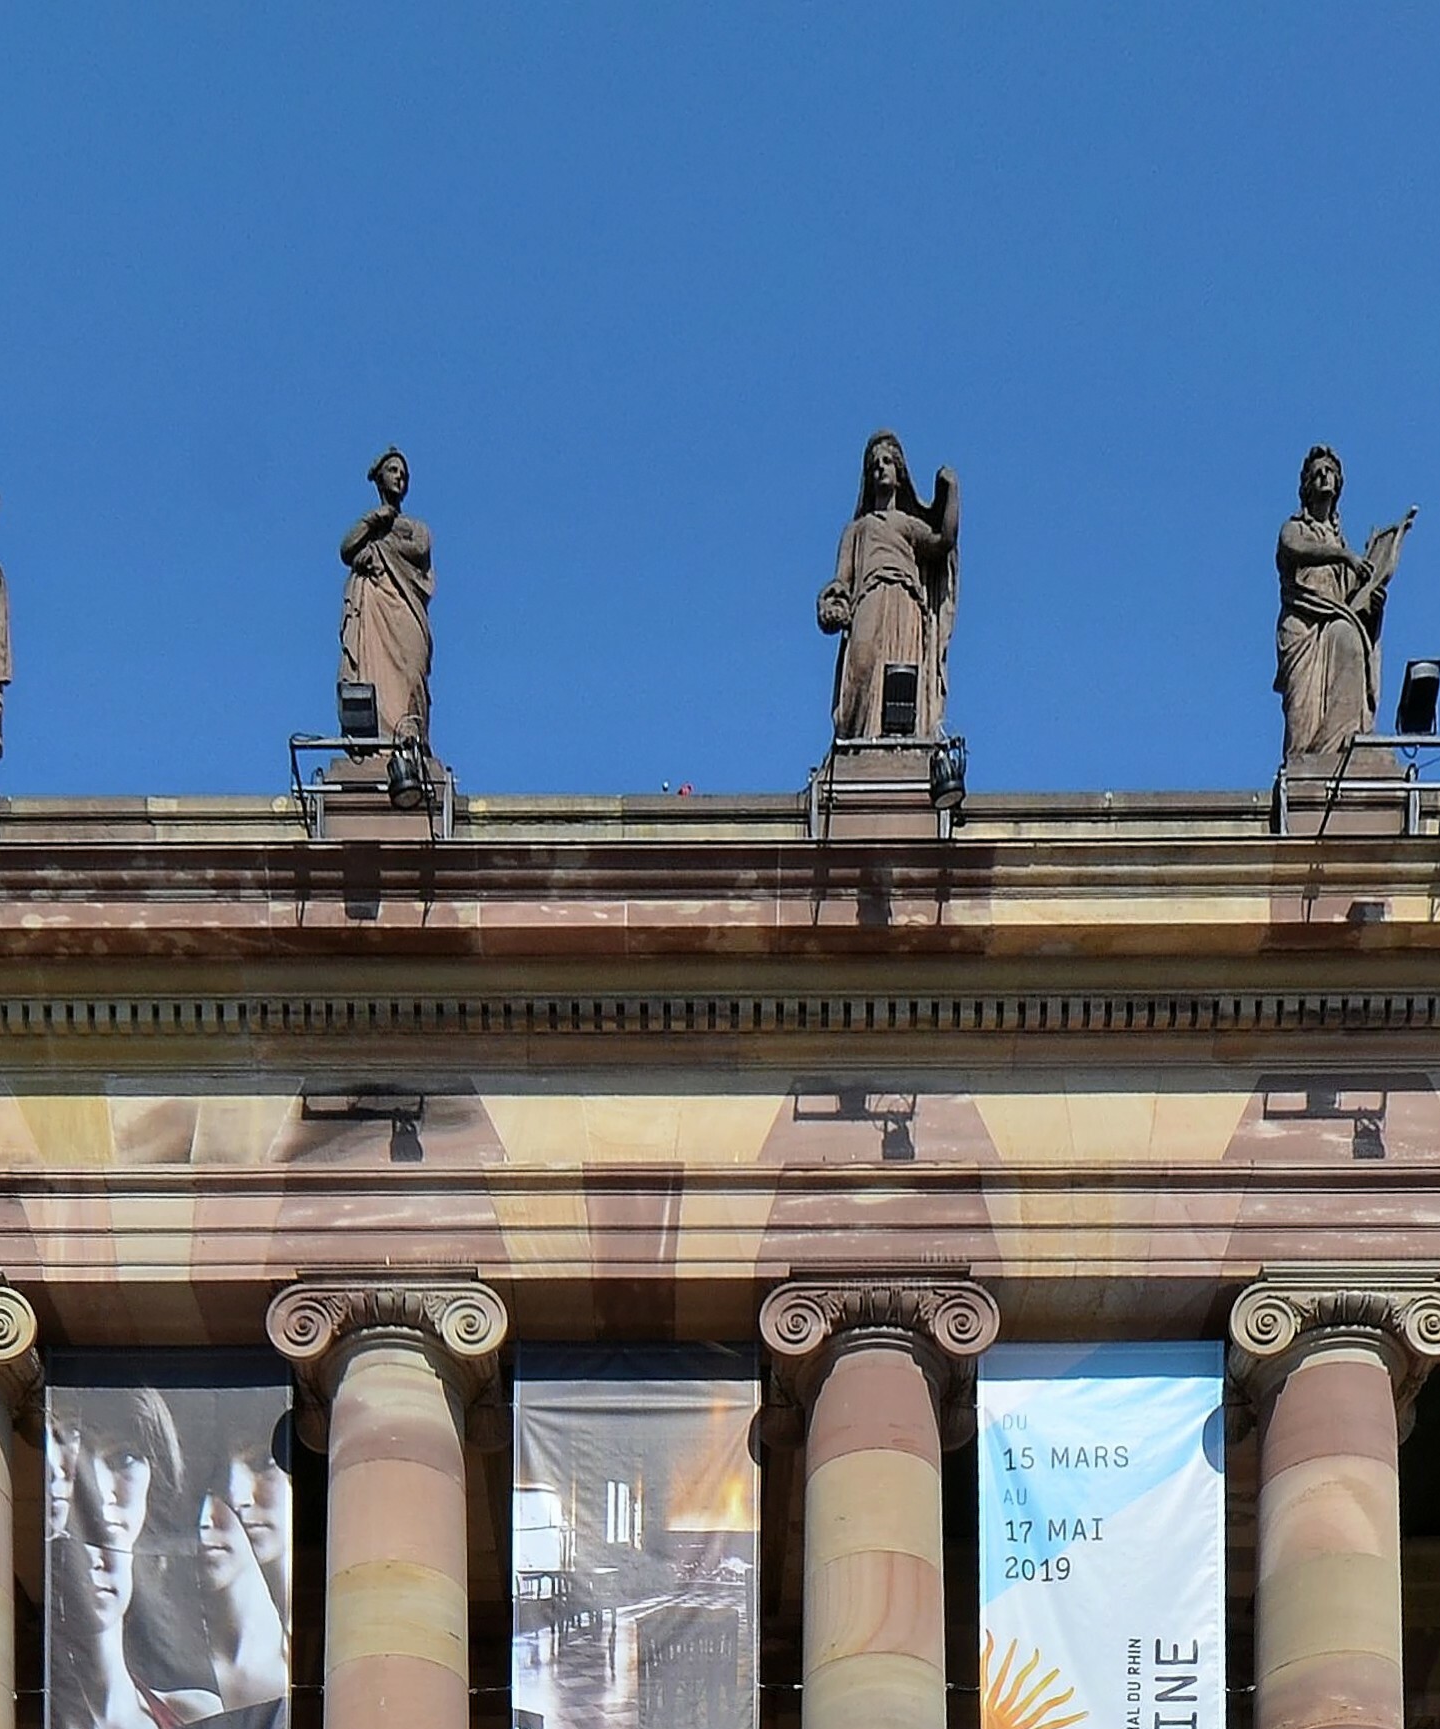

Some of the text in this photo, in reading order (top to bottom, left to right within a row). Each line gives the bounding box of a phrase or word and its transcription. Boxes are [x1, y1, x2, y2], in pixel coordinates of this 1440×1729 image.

[1002, 1413, 1027, 1430] DU
[1003, 1446, 1129, 1471] 15 MARS
[1003, 1488, 1028, 1505] AU
[1005, 1517, 1104, 1543] 17 MAI
[1005, 1556, 1071, 1582] 2019
[1127, 1638, 1142, 1675] RHIN
[1127, 1681, 1142, 1702] DU
